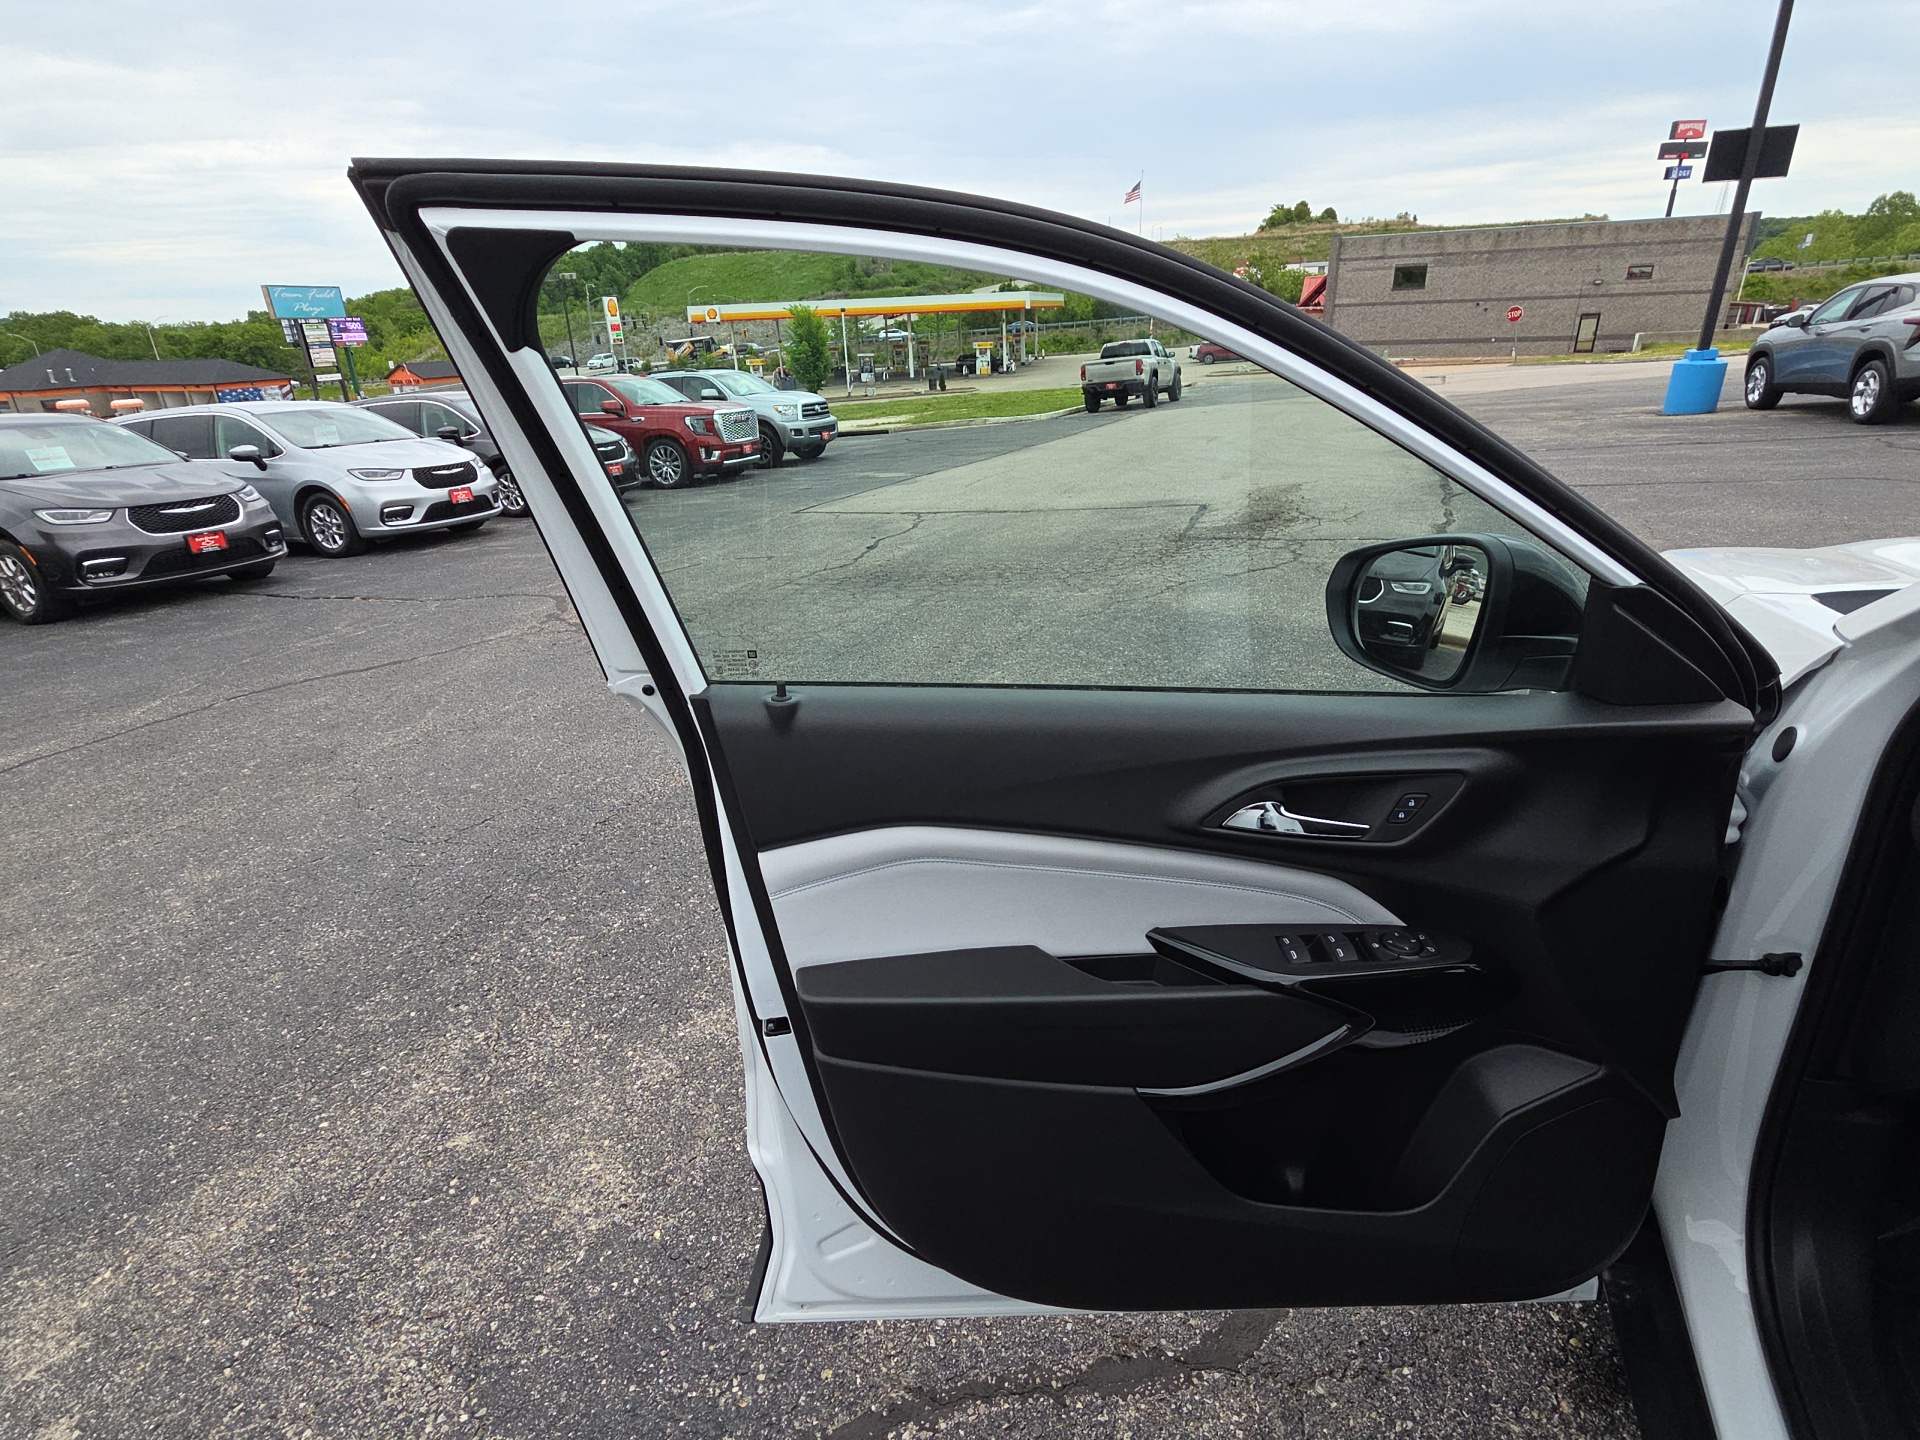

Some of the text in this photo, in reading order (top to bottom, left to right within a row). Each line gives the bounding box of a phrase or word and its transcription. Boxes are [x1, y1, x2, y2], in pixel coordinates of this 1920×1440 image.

[1678, 123, 1704, 133] MAVERIK
[273, 287, 335, 300] Town Field
[1508, 310, 1522, 318] STOP
